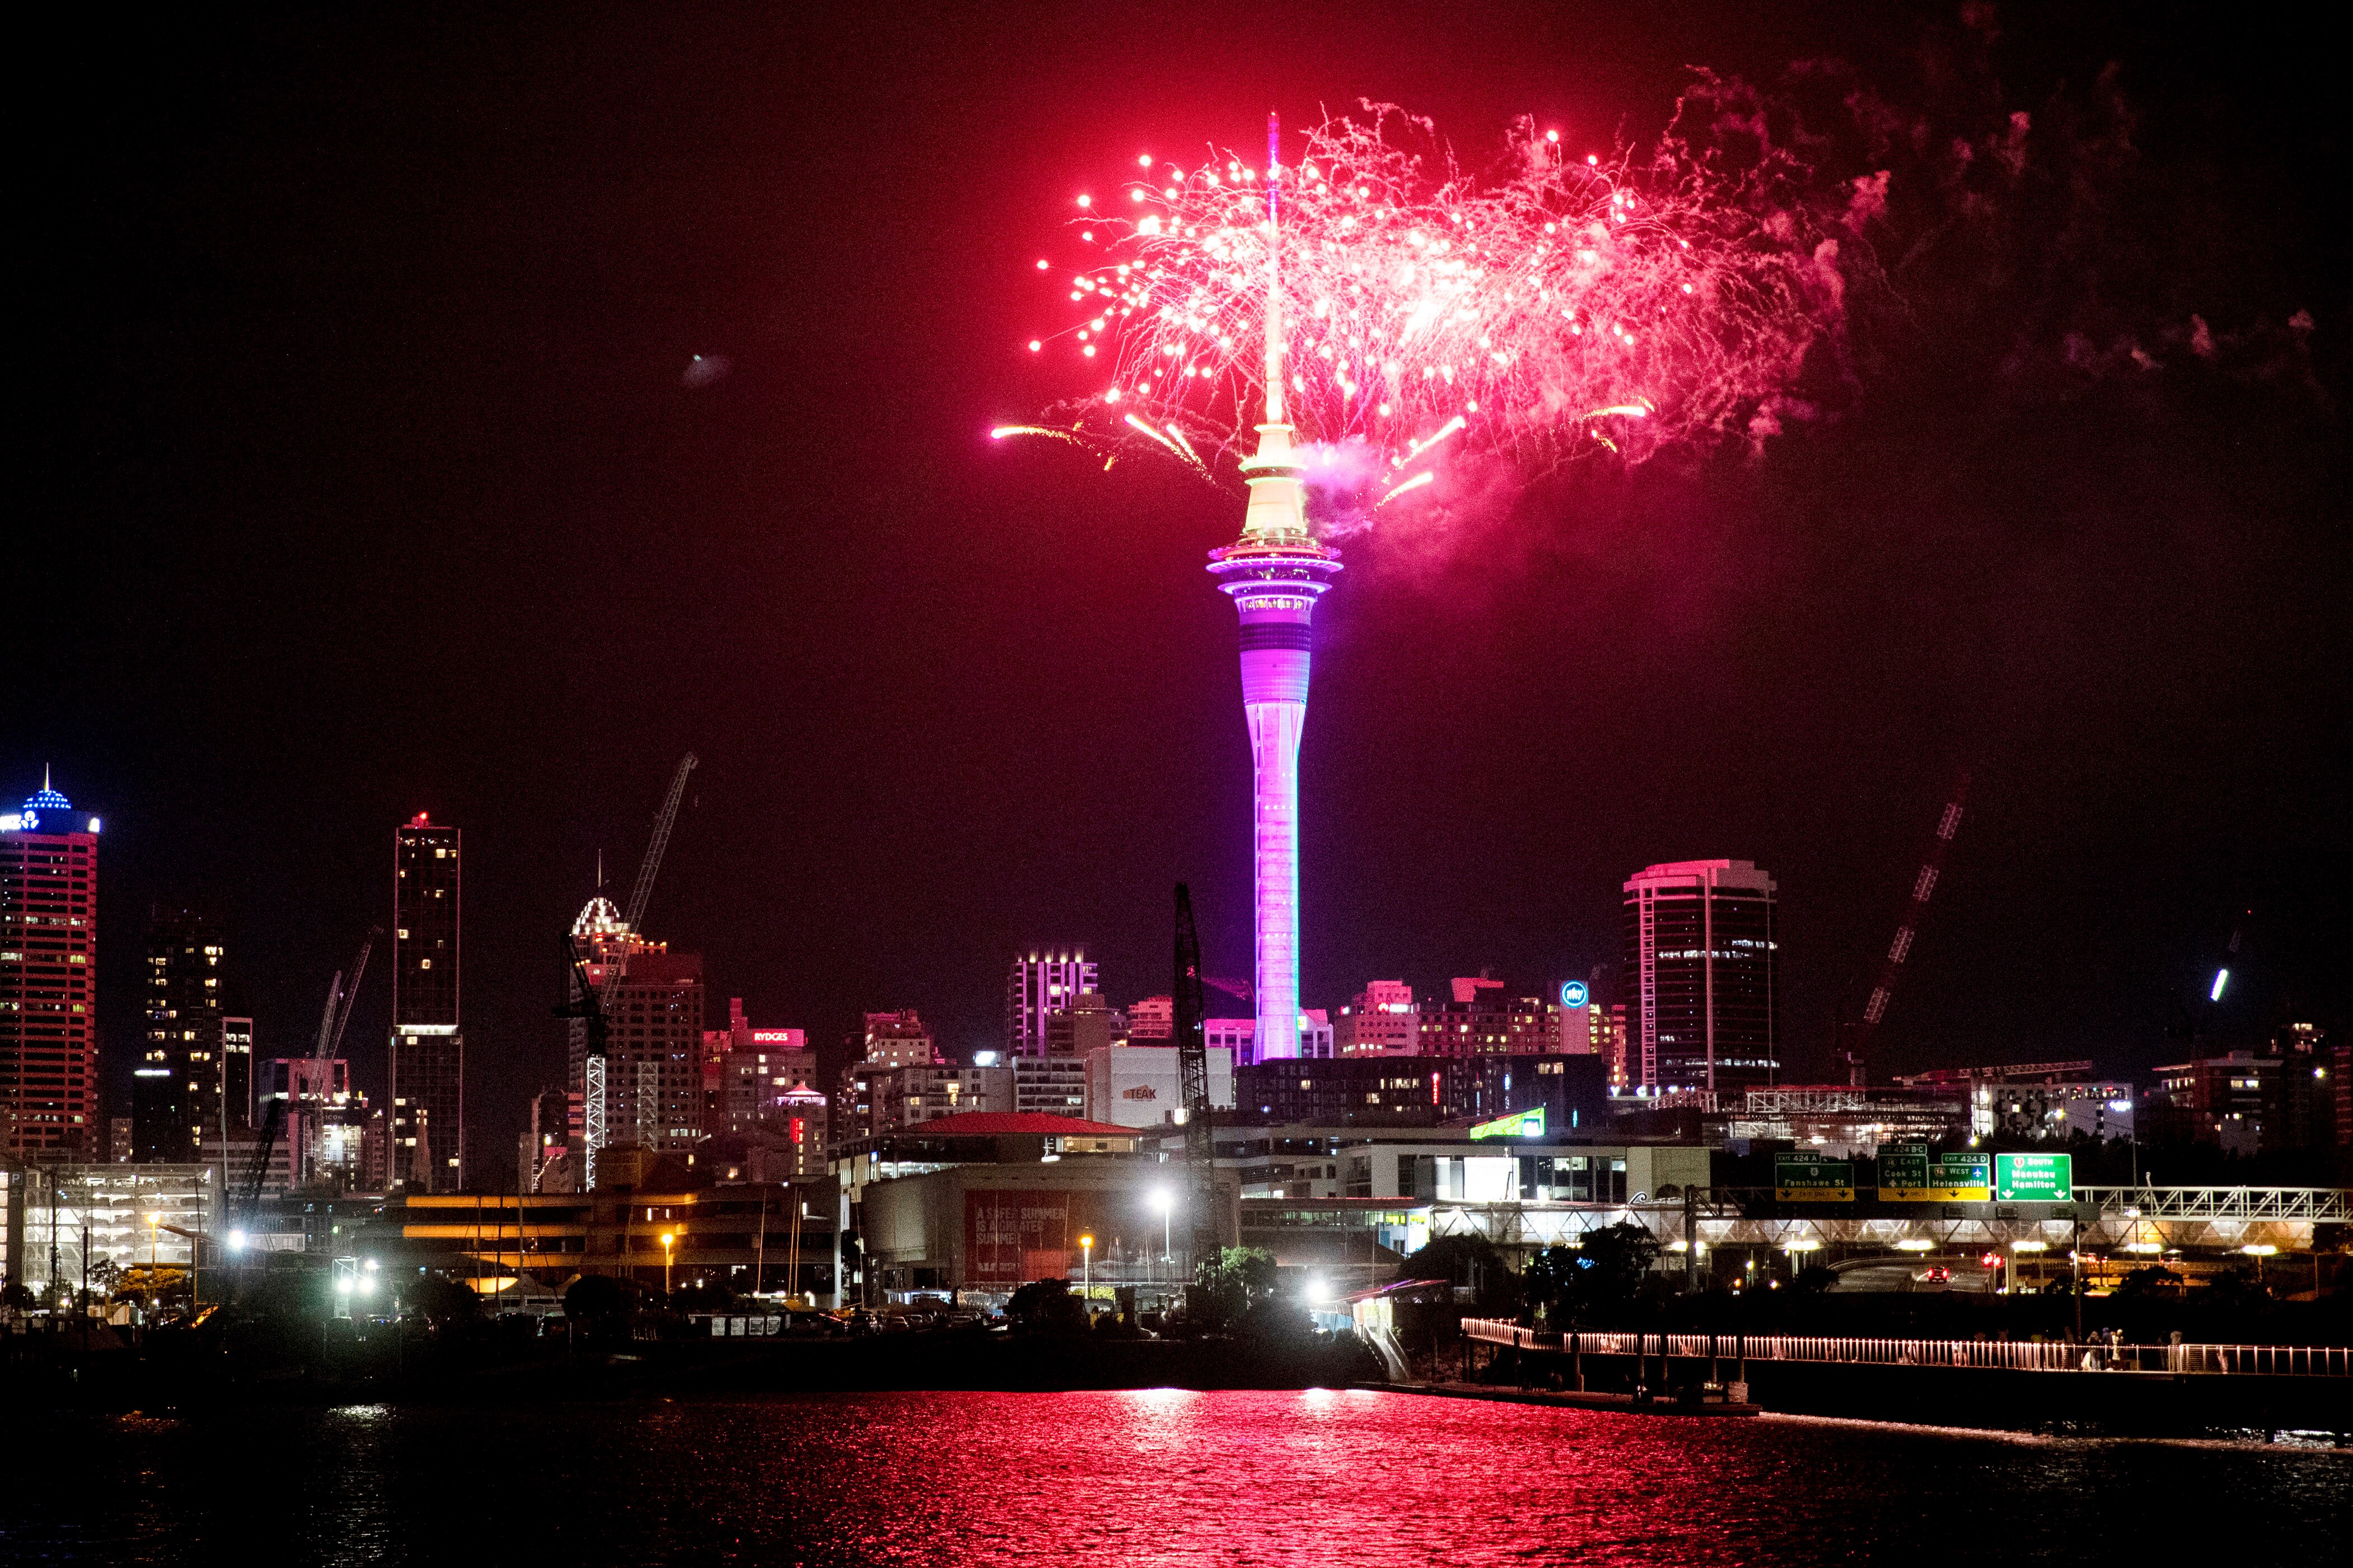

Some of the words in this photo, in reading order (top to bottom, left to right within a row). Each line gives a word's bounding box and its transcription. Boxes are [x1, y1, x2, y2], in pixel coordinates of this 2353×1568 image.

[754, 1032, 788, 1041] RYDGES
[1130, 1089, 1157, 1099] TEAK
[12, 1173, 20, 1183] P
[977, 1207, 984, 1219] A
[1021, 1207, 1065, 1219] SUMMER
[976, 1220, 986, 1232] IS
